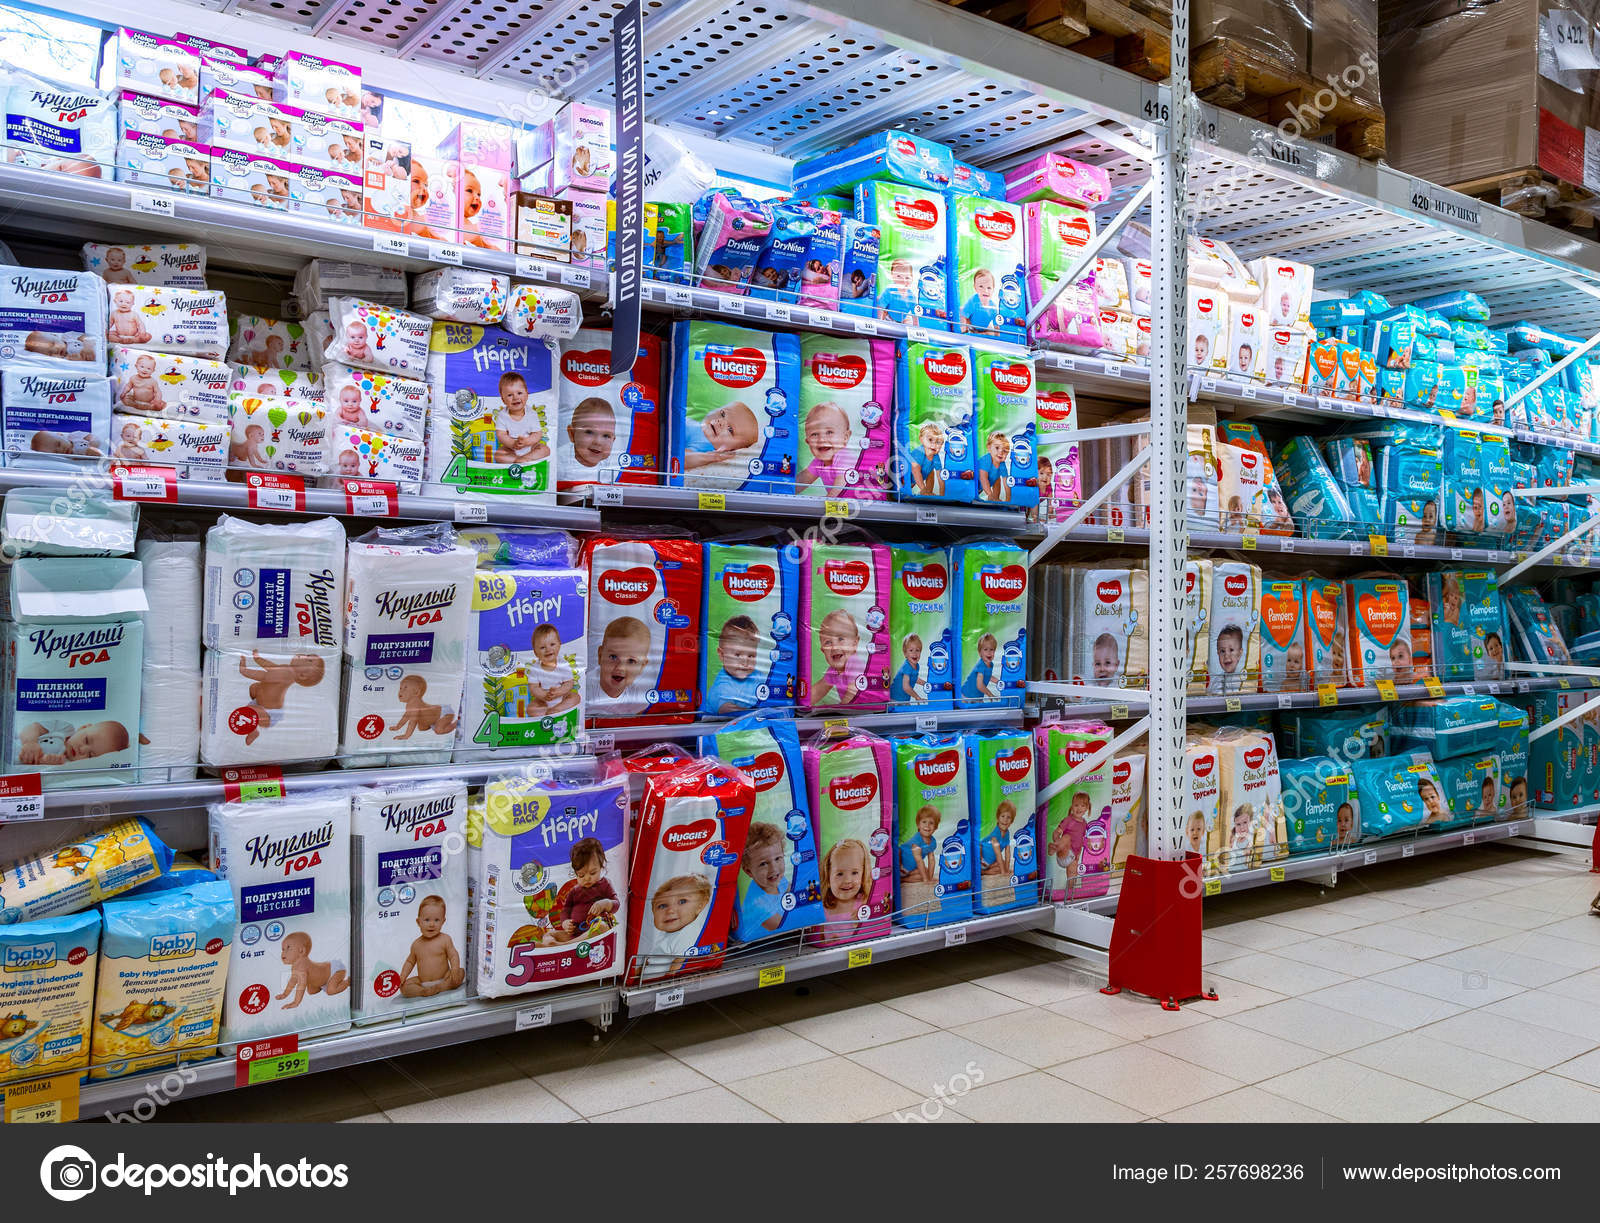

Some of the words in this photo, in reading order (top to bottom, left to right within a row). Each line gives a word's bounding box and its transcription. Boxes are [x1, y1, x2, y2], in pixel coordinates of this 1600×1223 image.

[1558, 26, 1566, 43] S
[1566, 24, 1585, 45] 422
[621, 18, 638, 129] ПЕЛЁНКИ
[304, 111, 325, 122] Helen
[1144, 100, 1169, 122] 416
[301, 116, 327, 126] Harper
[137, 139, 167, 150] Harper
[140, 134, 165, 144] Helen
[222, 155, 250, 166] Harper
[225, 151, 247, 161] Helen
[298, 171, 325, 182] Harper
[301, 167, 323, 177] Helen
[152, 199, 167, 207] 143
[1412, 193, 1429, 210] 420
[1435, 200, 1478, 224] ИГРУШКИ
[621, 137, 638, 302] ПОДГУЗНИКИ,
[812, 227, 840, 241] DryNites
[728, 239, 760, 252] DryNites
[774, 240, 804, 253] DryNites
[854, 240, 879, 254] DryNites
[12, 276, 78, 298] Круглый
[40, 292, 69, 304] ГОД
[191, 308, 210, 316] ГОД
[446, 324, 473, 335] BIG
[447, 336, 473, 345] PACK
[567, 360, 610, 376] HUGGIES
[711, 357, 758, 376] HUGGIES
[818, 364, 859, 379] HUGGIES
[928, 361, 964, 376] HUGGIES
[578, 373, 600, 381] Classic
[994, 372, 1028, 386] HUGGIES
[49, 393, 77, 404] ГОД
[628, 392, 638, 400] 12
[197, 445, 216, 453] ГОД
[752, 461, 760, 470] 3
[440, 453, 472, 494] 4
[492, 476, 504, 484] 66
[729, 575, 768, 589] HUGGIES
[829, 572, 864, 584] HUGGIES
[906, 574, 944, 589] HUGGIES
[985, 576, 1023, 589] HUGGIES
[479, 579, 506, 593] BIG
[604, 579, 649, 592] HUGGIES
[376, 583, 457, 622] Круглый
[481, 591, 507, 602] PACK
[264, 582, 274, 625] ДЕТСКИЕ
[273, 572, 286, 635] ПОДГУЗНИКИ
[305, 568, 338, 648] Круглый
[1470, 605, 1498, 615] Pampers
[407, 609, 443, 628] ГОД
[662, 608, 672, 616] 12
[1268, 611, 1294, 622] Pampers
[1367, 610, 1397, 621] Pampers
[294, 602, 312, 637] ГОД
[29, 622, 125, 659] Круглый
[370, 639, 431, 651] ПОДГУЗНИКИ
[69, 650, 111, 668] ГОД
[379, 649, 420, 659] ДЕТСКИЕ
[362, 684, 373, 692] 64
[20, 691, 100, 699] ВПИТЫВАЮЩИЕ
[473, 711, 503, 751] 4
[524, 729, 536, 738] 66
[1501, 751, 1526, 763] Pampers
[919, 762, 956, 776] HUGGIES
[999, 758, 1029, 772] HUGGIES
[835, 787, 871, 799] HUGGIES
[1385, 780, 1412, 793] Pampers
[17, 804, 35, 812] 268
[512, 800, 540, 817] BIG
[1305, 800, 1335, 815] Pampers
[513, 812, 539, 826] PACK
[414, 820, 447, 841] ГОД
[668, 831, 708, 843] HUGGIES
[245, 821, 335, 868] Круглый
[709, 849, 720, 858] 12
[284, 851, 321, 876] ГОД
[381, 853, 439, 870] ПОДГУЗНИКИ
[391, 866, 430, 878] ДЕТСКИЕ
[245, 886, 311, 904] ПОДГУЗНИКИ
[785, 894, 793, 905] 5
[256, 899, 301, 915] ДЕТСКИЕ
[378, 911, 389, 919] 56
[153, 935, 195, 952] baby
[206, 941, 223, 952] NEW!
[7, 945, 55, 962] baby
[69, 950, 87, 962] NEW!
[160, 947, 192, 958] line
[240, 950, 251, 959] 64
[254, 950, 265, 958] шт
[16, 957, 48, 968] line
[142, 969, 175, 978] Hygiene
[177, 960, 218, 973] Underpads
[505, 942, 536, 988] 5
[560, 957, 572, 968] 58
[37, 971, 83, 984] Underpads
[123, 977, 157, 987] Детские
[160, 969, 214, 983] гигиенические
[382, 975, 392, 992] 5
[125, 983, 177, 995] одноразовые
[179, 978, 210, 989] пеленки
[247, 990, 260, 1009] 4
[668, 994, 680, 1002] 989
[530, 1013, 544, 1022] 770
[256, 1042, 270, 1050] ВСЕГДА
[256, 1050, 271, 1058] НИЗКАЯ
[272, 1048, 284, 1056] ЦЕНА
[278, 1060, 300, 1072] 599
[8, 1082, 51, 1096] РАСПРОДАЖА
[35, 1110, 51, 1120] 199
